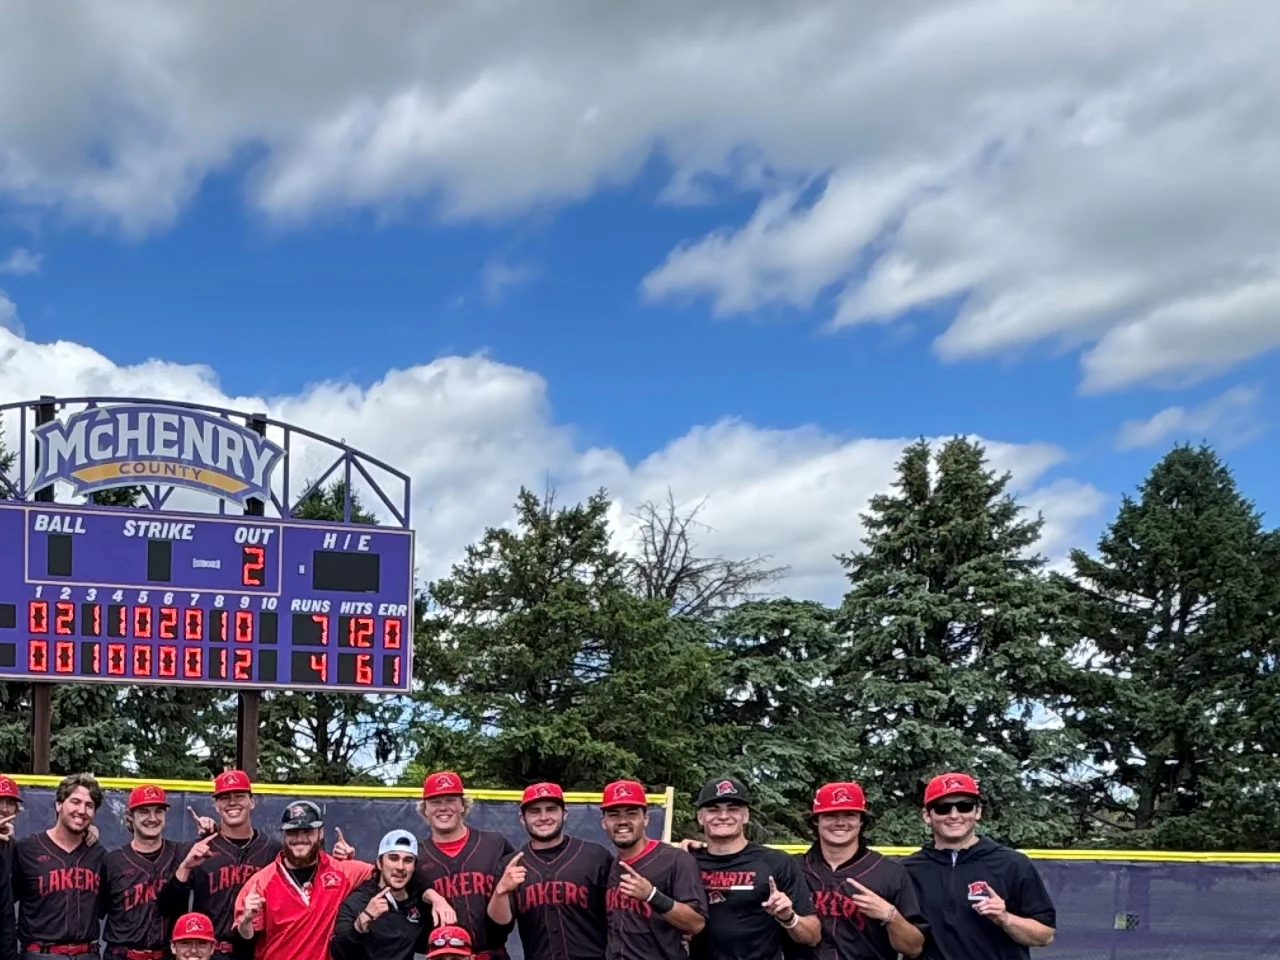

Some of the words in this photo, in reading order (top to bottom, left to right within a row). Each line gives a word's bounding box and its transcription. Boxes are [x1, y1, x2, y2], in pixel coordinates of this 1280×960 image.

[118, 462, 203, 480] COUNTY
[34, 514, 86, 534] BALL
[123, 519, 195, 541] STRIKE
[234, 527, 274, 545] OUT
[243, 546, 265, 586] 2
[35, 586, 43, 598] 1
[60, 587, 71, 600] 2
[86, 588, 97, 601] 3
[112, 589, 124, 602] 4
[137, 591, 149, 604] 5
[163, 592, 174, 605] 6
[190, 593, 200, 606] 7
[214, 595, 225, 607] 8
[240, 596, 251, 609] 9
[261, 597, 278, 610] 10
[291, 598, 331, 613] RUNS
[340, 601, 373, 615] HITS
[378, 603, 407, 617] ERR
